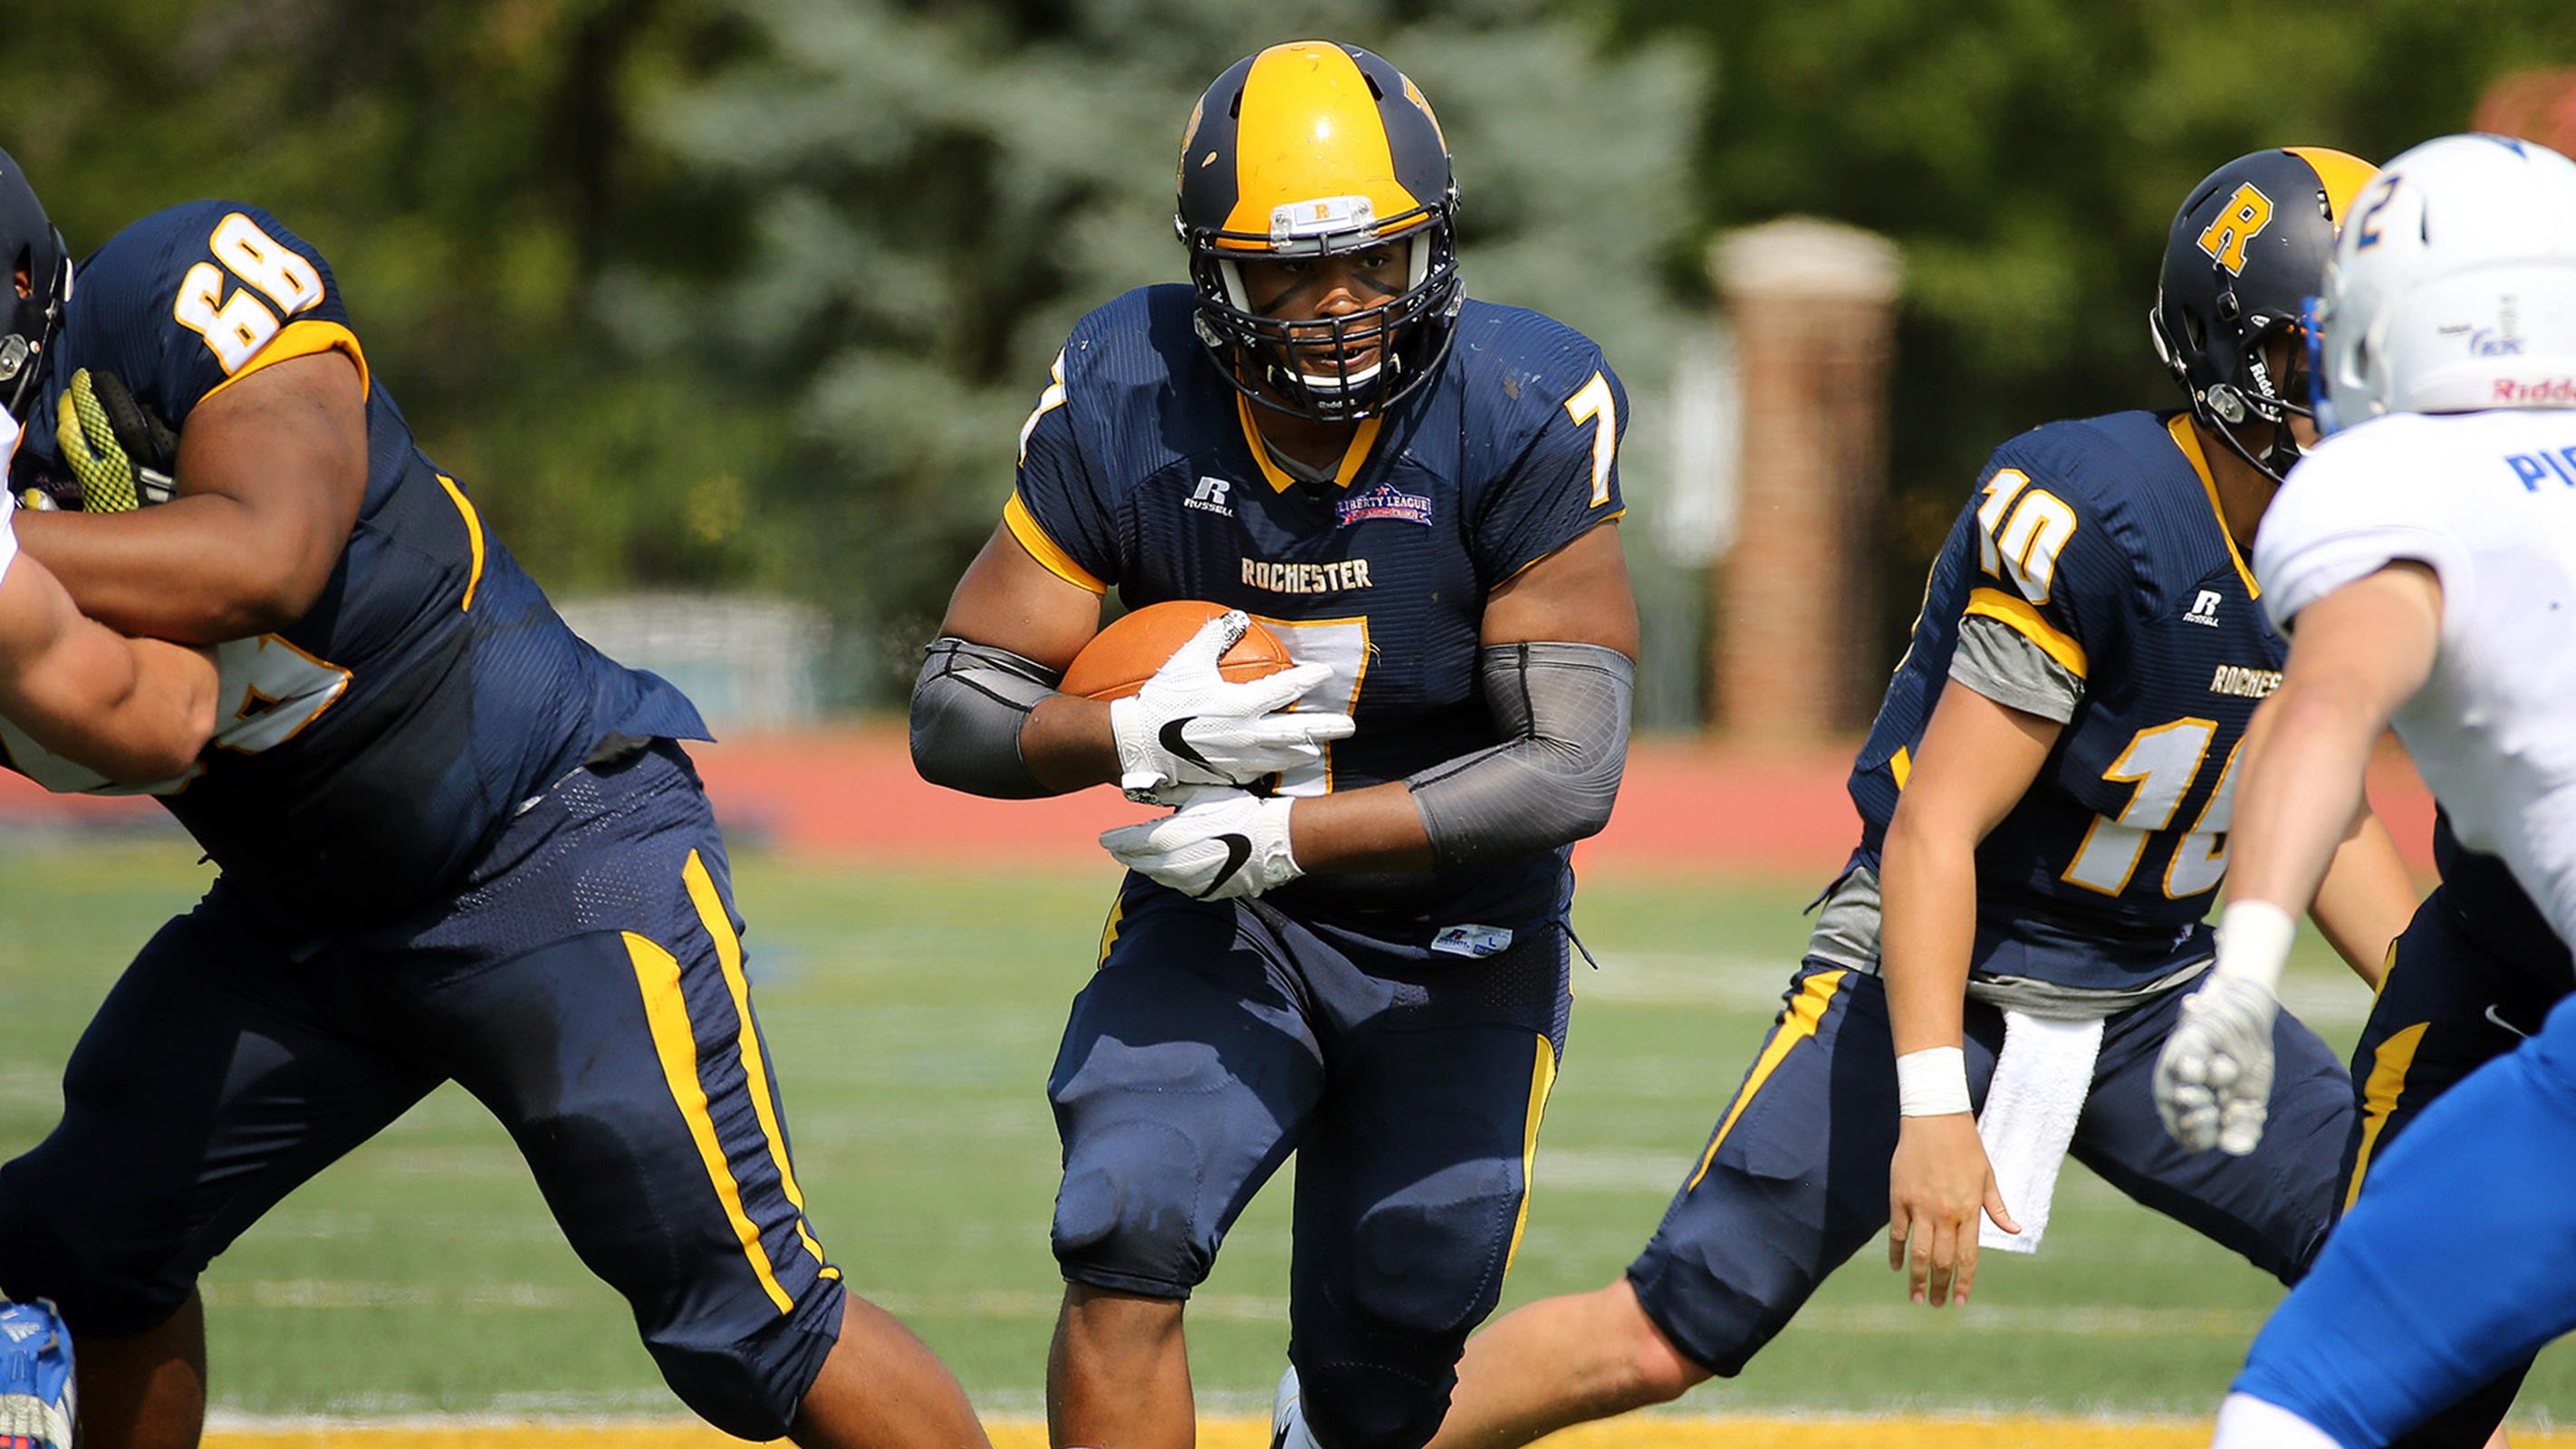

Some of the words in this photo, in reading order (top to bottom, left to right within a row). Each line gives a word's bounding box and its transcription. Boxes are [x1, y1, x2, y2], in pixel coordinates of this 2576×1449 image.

[1315, 204, 1331, 220] R
[2196, 181, 2274, 278] R
[2357, 176, 2403, 250] 2
[173, 212, 326, 378] 68
[2493, 378, 2576, 401] Ridd
[1563, 369, 1618, 509] 7
[1183, 497, 1235, 518] RUSSELL
[1338, 495, 1384, 512] LIBERTY
[1387, 495, 1428, 511] LEAGUE
[1976, 467, 2079, 606] 10
[1241, 556, 1373, 594] ROCHESTER
[2209, 664, 2283, 698] ROCHES
